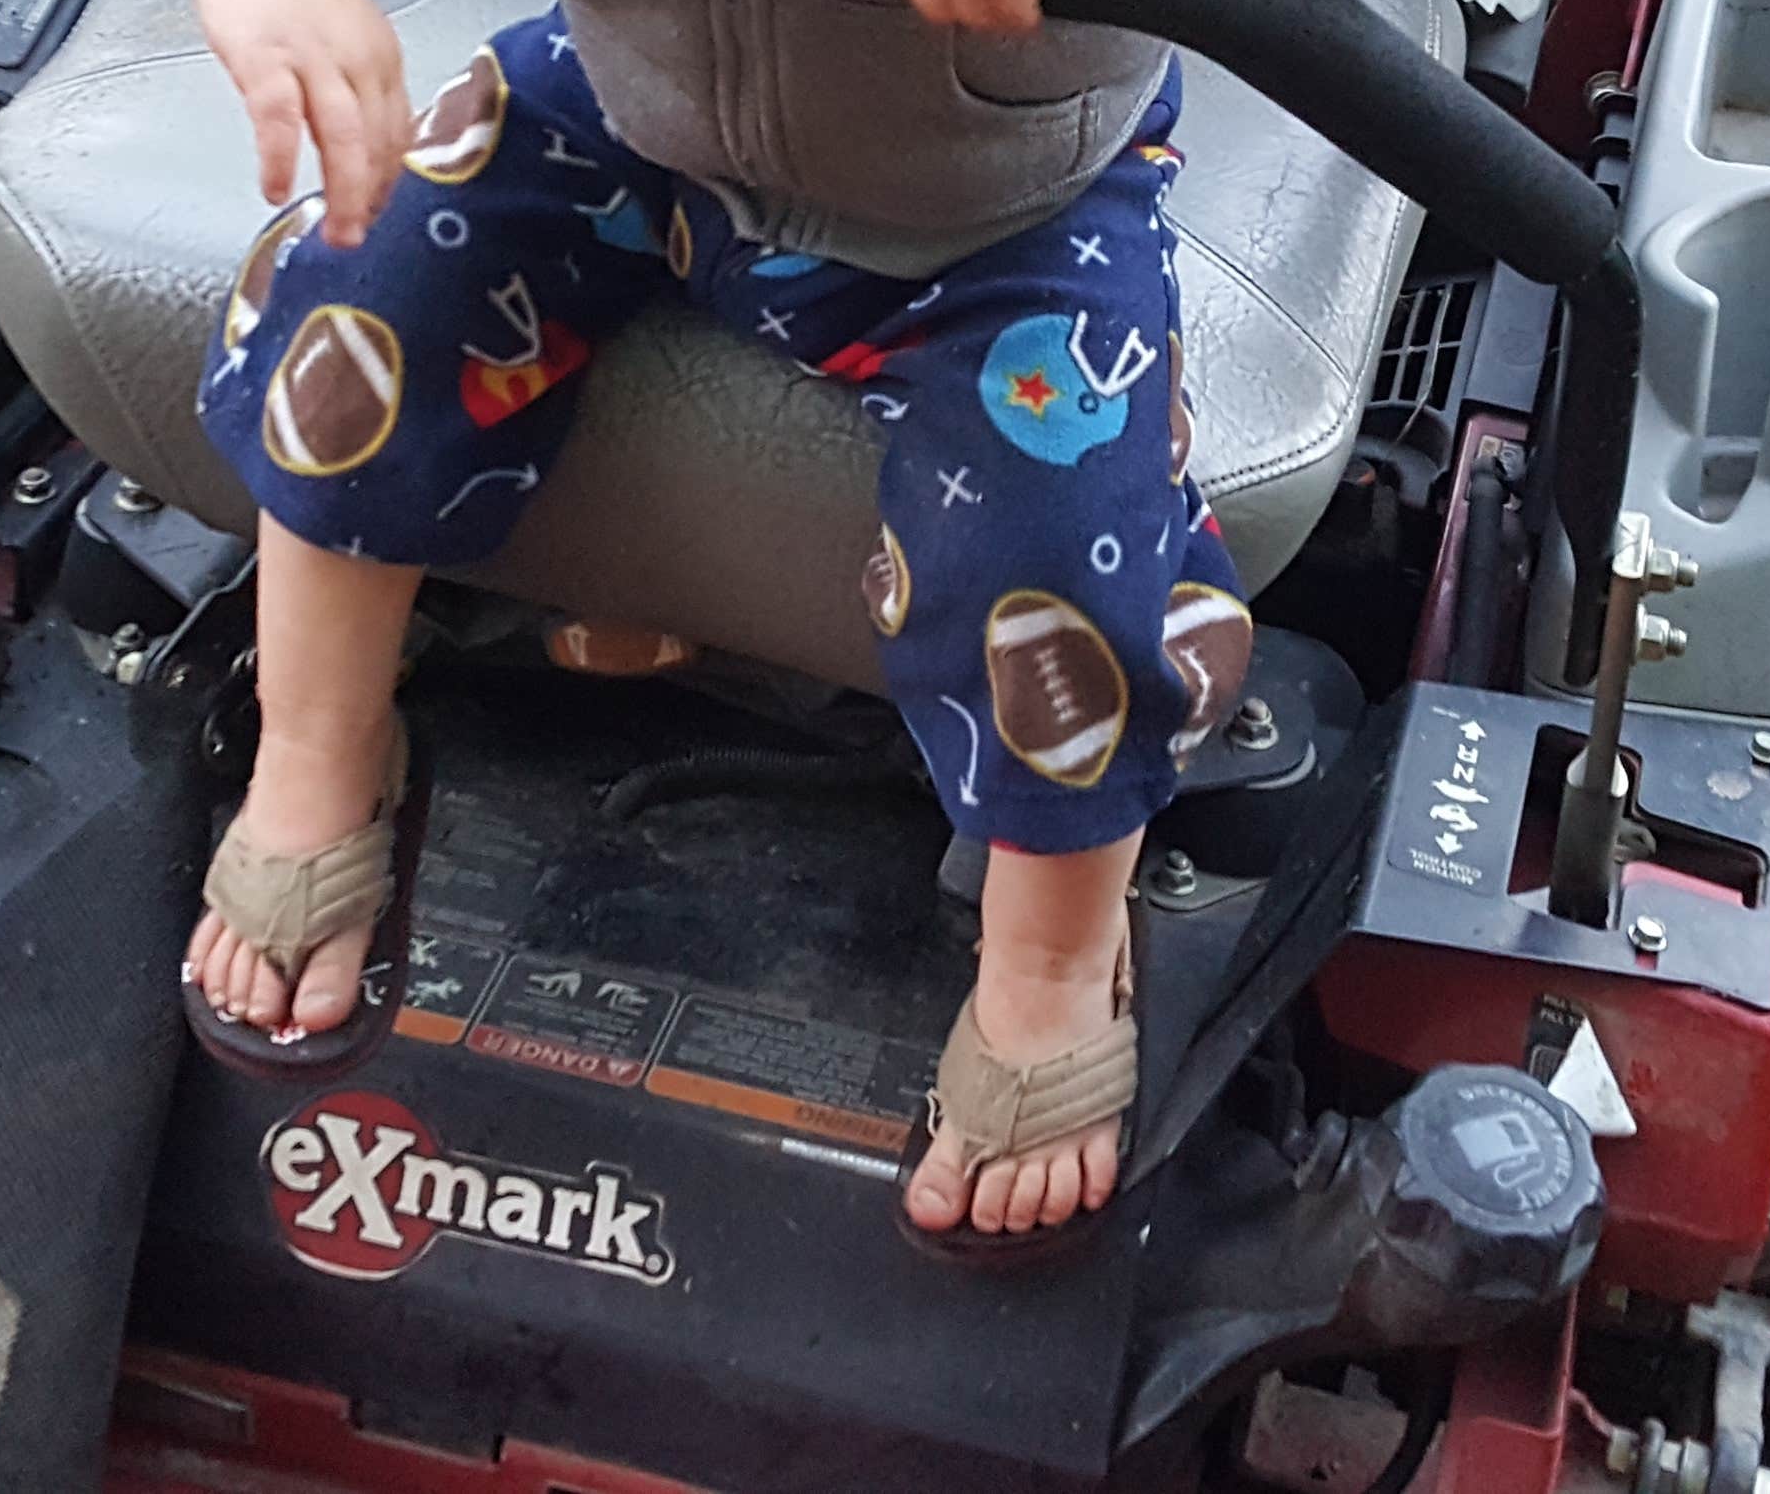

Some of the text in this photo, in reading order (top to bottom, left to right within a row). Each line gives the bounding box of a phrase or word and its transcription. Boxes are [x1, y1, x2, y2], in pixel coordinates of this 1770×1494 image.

[1409, 848, 1483, 879] CONTROL
[1413, 860, 1474, 886] MOTION
[481, 1032, 601, 1074] DANGER
